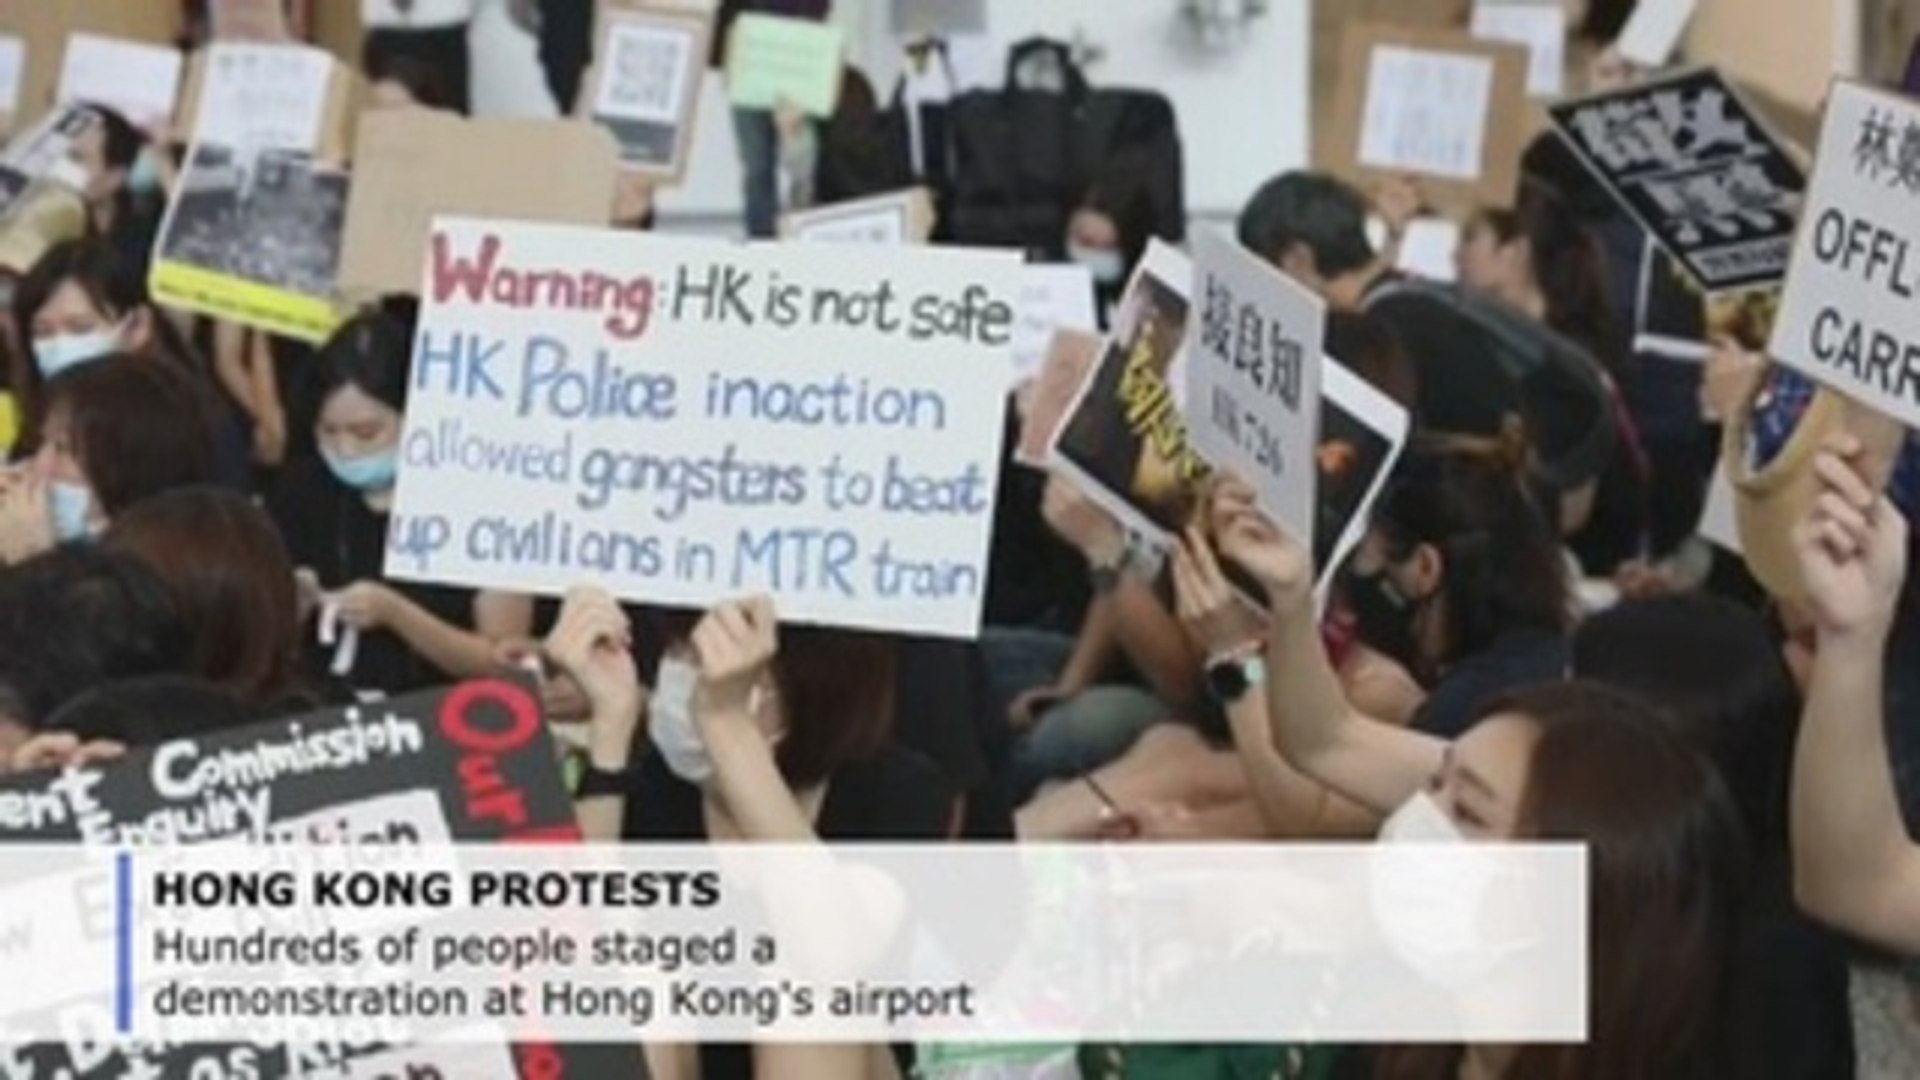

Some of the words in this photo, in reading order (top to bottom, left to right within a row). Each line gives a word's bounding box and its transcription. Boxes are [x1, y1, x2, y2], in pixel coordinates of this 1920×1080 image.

[1814, 207, 1920, 298] OFFL
[671, 264, 754, 325] HK
[764, 272, 799, 322] is
[811, 281, 900, 333] not
[908, 285, 1012, 346] safe
[416, 331, 504, 400] HK
[518, 336, 676, 420] Police
[704, 372, 946, 430] inaction
[1809, 306, 1920, 406] CARR
[404, 419, 574, 477] allowed
[577, 446, 804, 521] gangsters
[823, 470, 873, 507] to
[882, 459, 985, 515] beat
[389, 513, 451, 572] up
[467, 513, 661, 578] civilians
[674, 536, 715, 582] in
[731, 528, 857, 596] MTR
[871, 550, 978, 598] train
[152, 707, 424, 799] Commission
